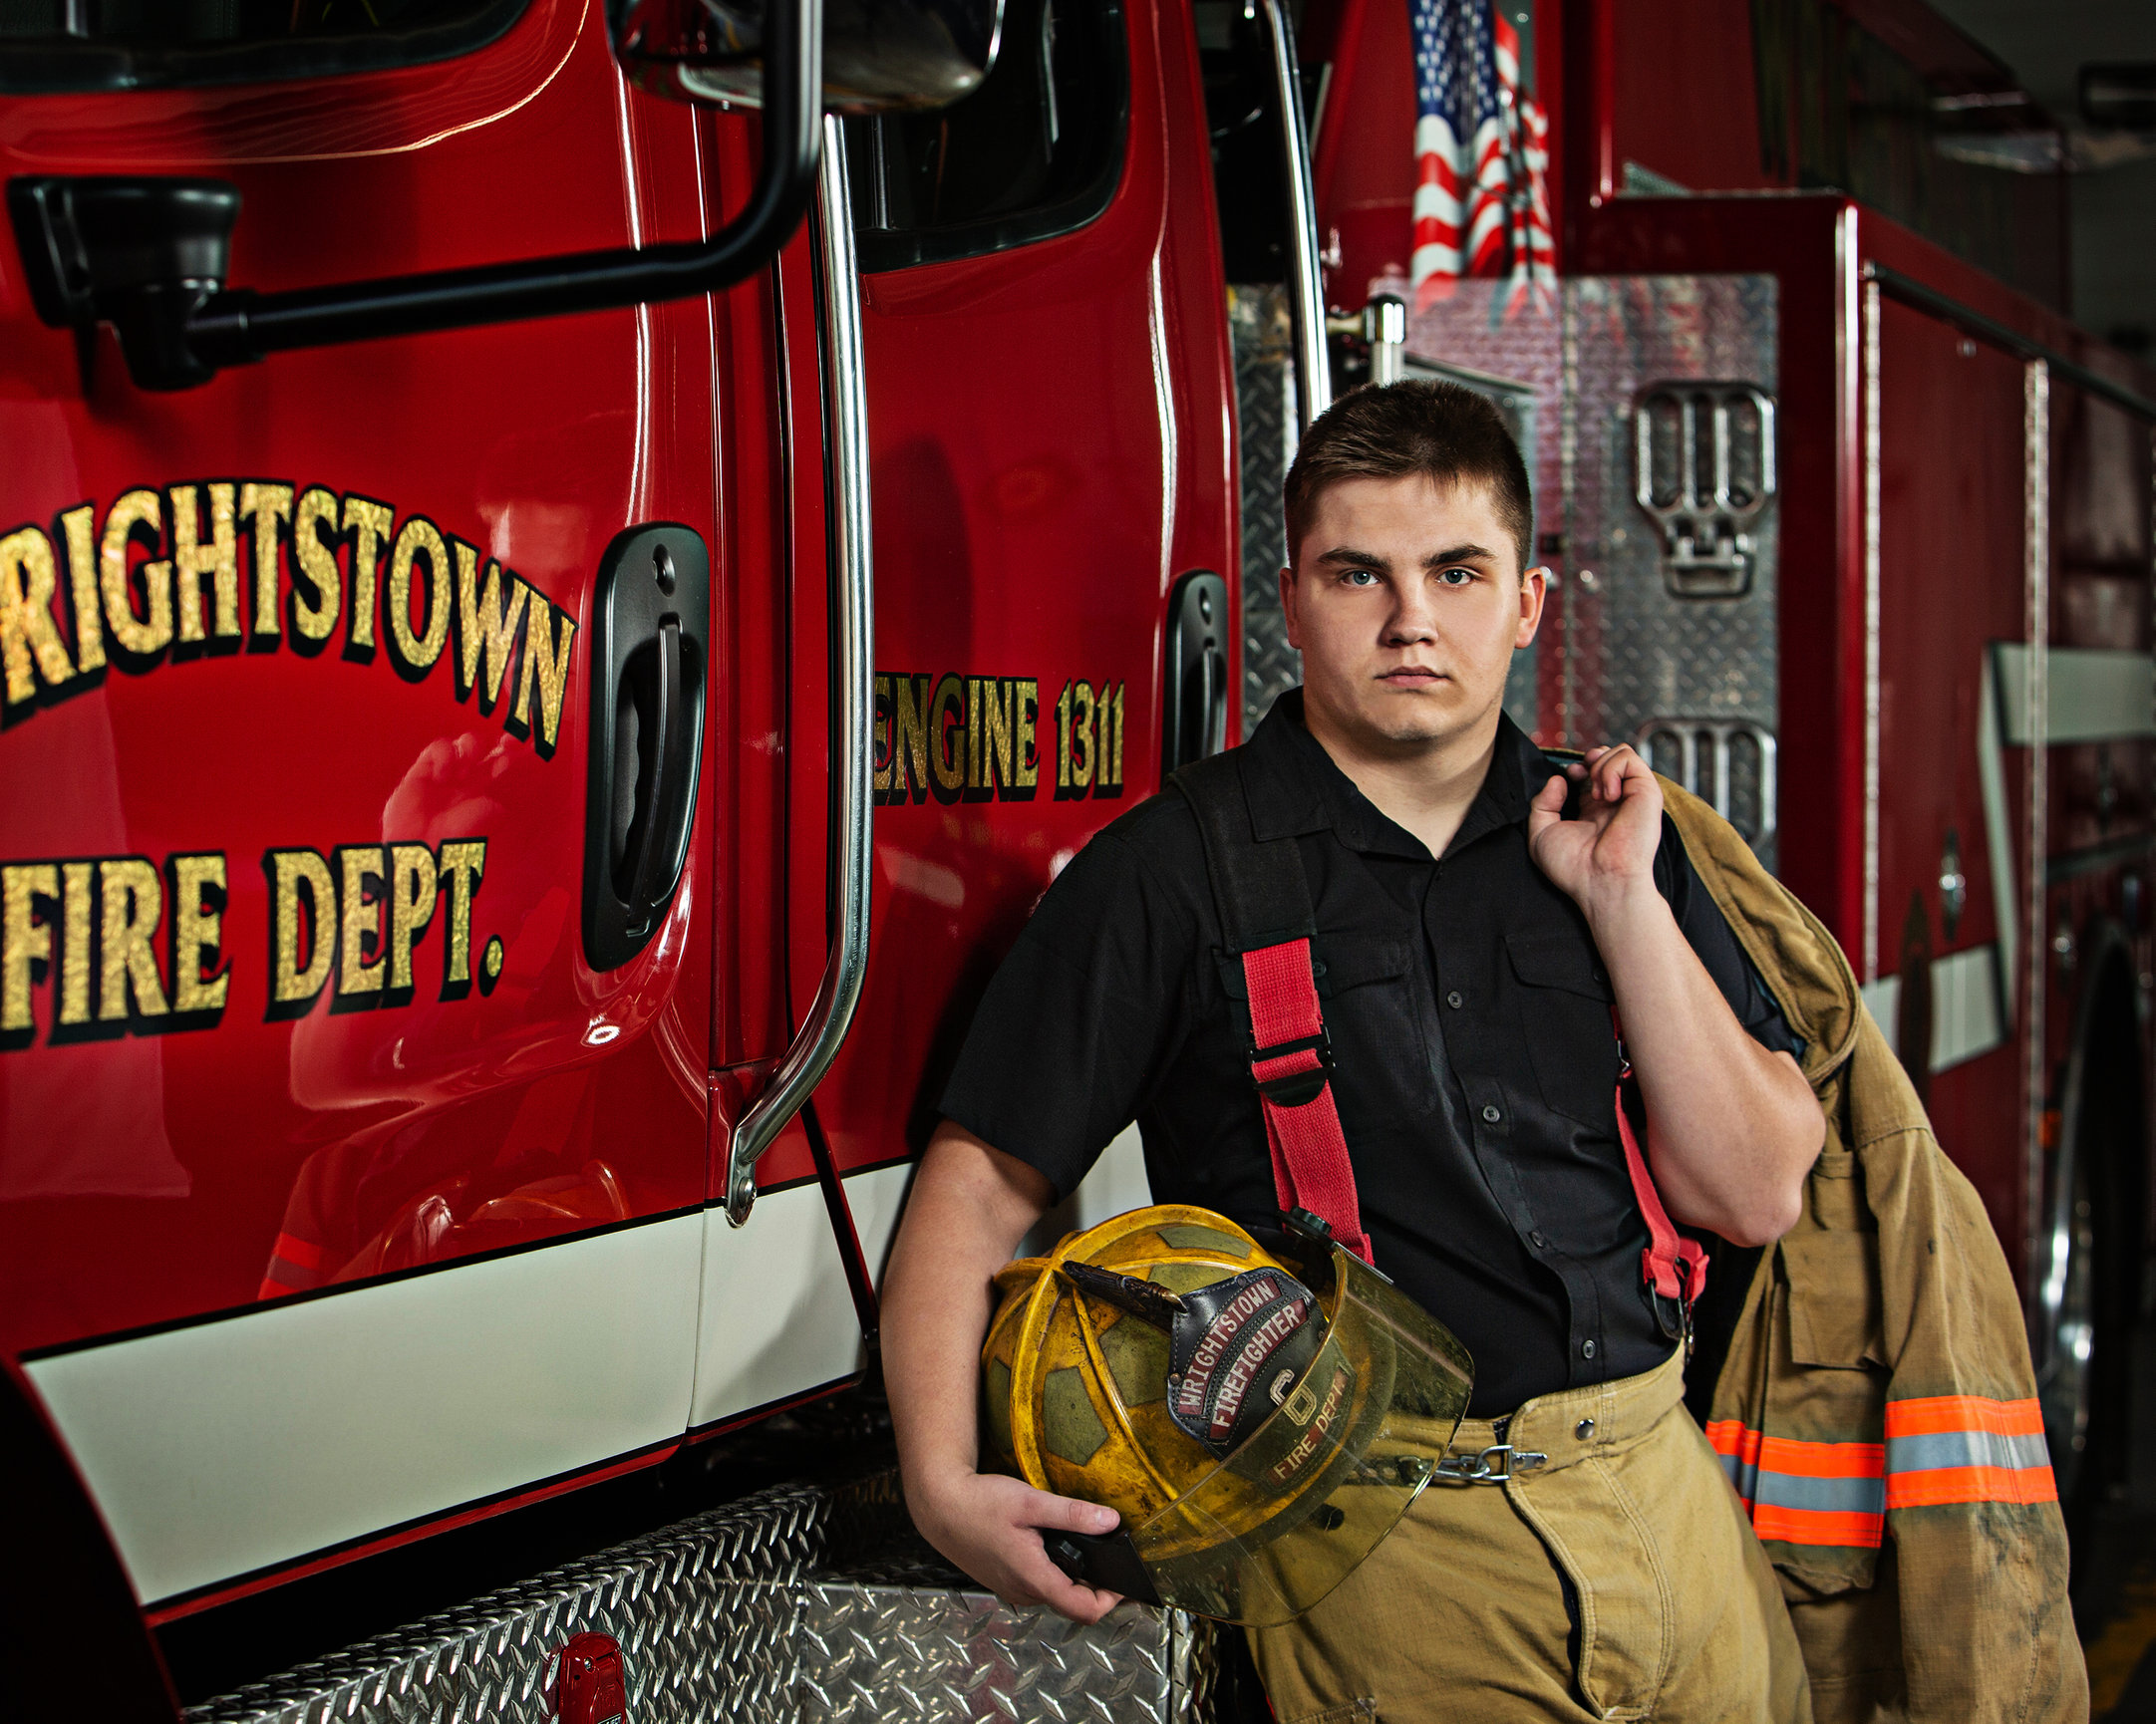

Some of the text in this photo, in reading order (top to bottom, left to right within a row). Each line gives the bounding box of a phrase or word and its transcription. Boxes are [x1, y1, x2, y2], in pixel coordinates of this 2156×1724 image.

[1057, 679, 1125, 798] 1311
[0, 839, 504, 1041] FIRE DEPT.
[1179, 1280, 1275, 1407] WRIGHTSTOWN
[1212, 1304, 1301, 1428] FIREFIGHTER
[1273, 1433, 1317, 1480] FIRE
